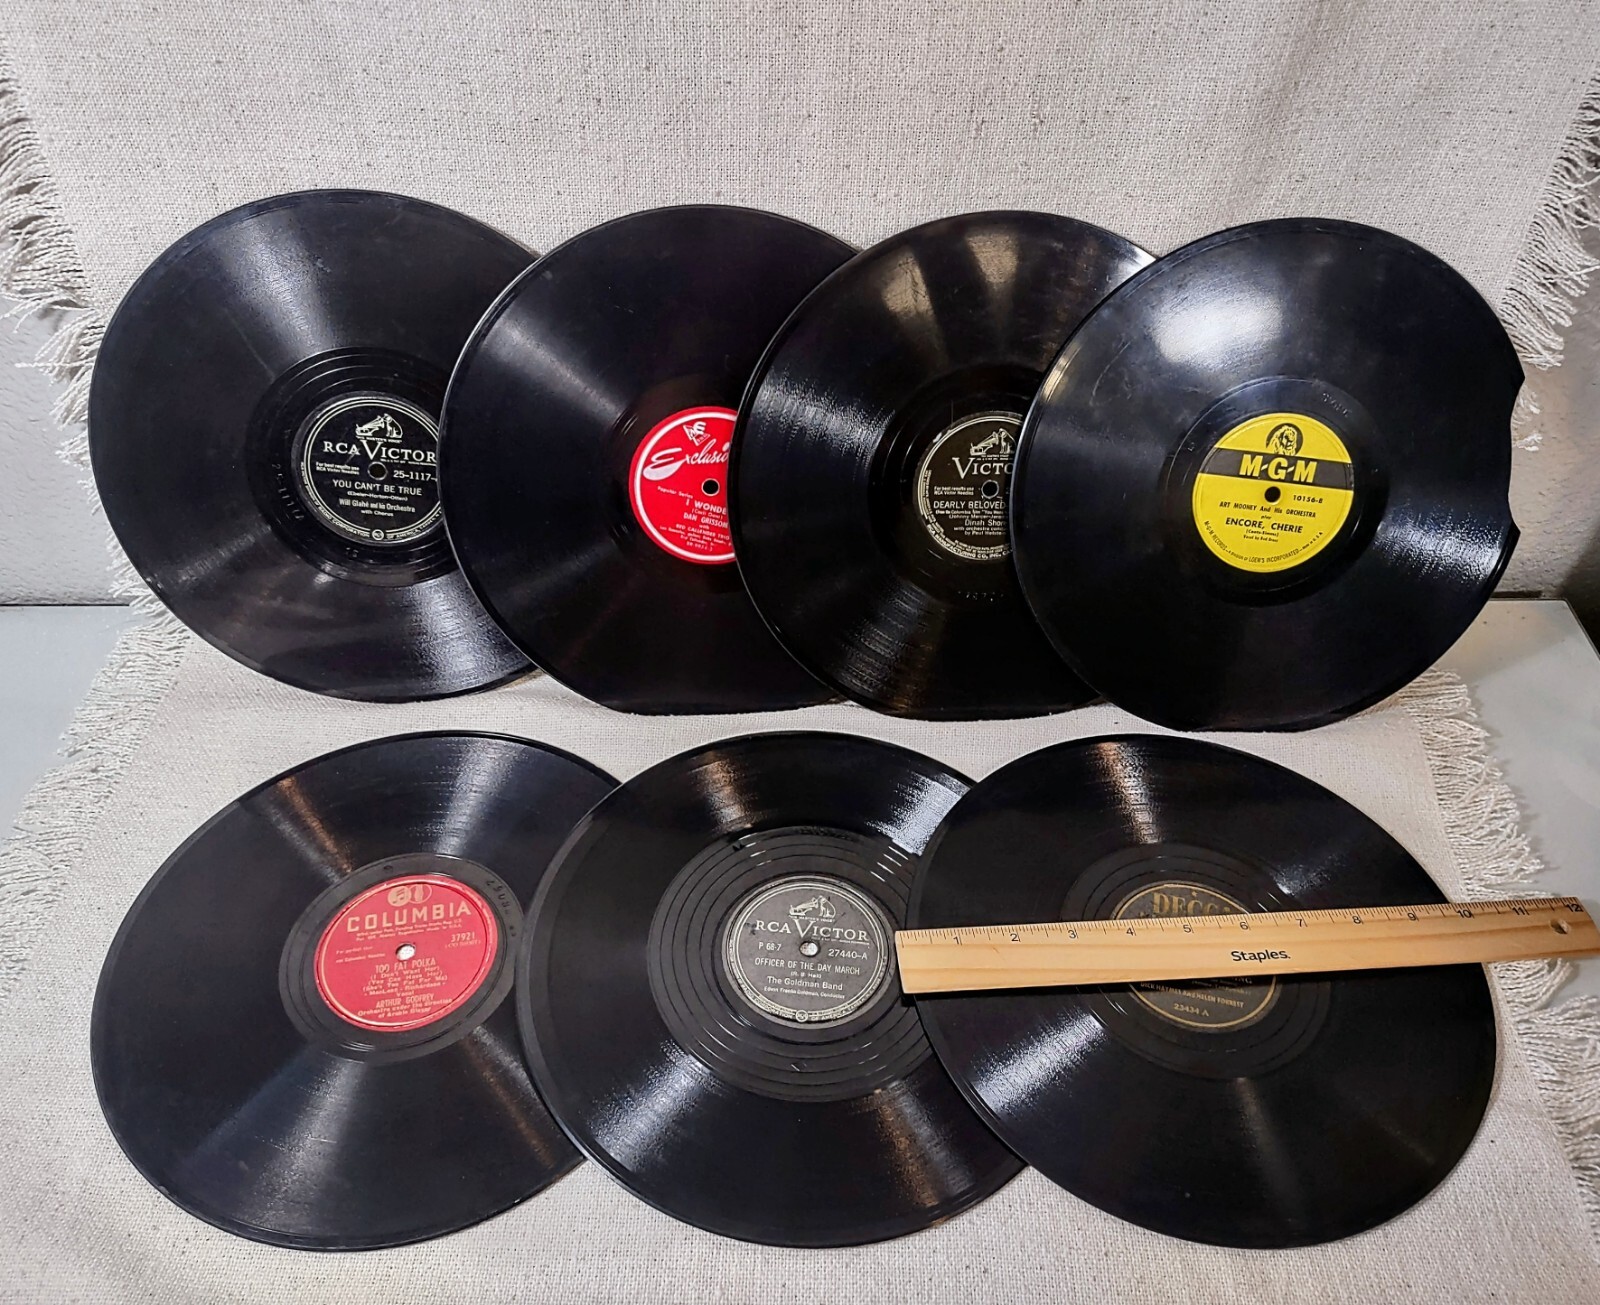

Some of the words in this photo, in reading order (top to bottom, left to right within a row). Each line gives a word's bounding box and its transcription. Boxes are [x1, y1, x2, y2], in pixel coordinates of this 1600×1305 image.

[323, 441, 360, 456] RCA
[360, 439, 437, 463] VICTOR
[951, 456, 1014, 480] VICTO
[393, 470, 437, 482] 25-1117-
[332, 478, 352, 489] YOU
[354, 481, 381, 492] CAN'T
[383, 484, 396, 493] BE
[397, 485, 422, 496] TRUE
[386, 503, 415, 513] Orchestra
[694, 500, 727, 515] WONDE
[933, 500, 966, 509] DEARLY
[968, 500, 1006, 510] BELOVED
[1219, 501, 1231, 509] ART
[1233, 502, 1257, 511] MOONEY
[1259, 505, 1271, 513] And
[1285, 508, 1316, 518] ORCHESTRA
[683, 511, 698, 522] DAN
[964, 519, 985, 527] Dinah
[1225, 517, 1265, 530] ENCORE,
[1270, 522, 1303, 534] CHERIE
[1152, 892, 1230, 917] DECC
[346, 902, 472, 933] COLUMBIA
[755, 919, 792, 934] RCA
[793, 919, 870, 941] VICTOR
[953, 936, 960, 945] 1
[1010, 933, 1018, 942] 2
[1067, 929, 1076, 939] 3
[1125, 927, 1134, 936] 4
[1183, 924, 1192, 933] 5
[1239, 921, 1249, 931] 6
[1295, 918, 1303, 927] 7
[1352, 915, 1361, 924] 8
[1407, 912, 1417, 921] 9
[1456, 909, 1472, 918] 10
[450, 931, 475, 943] 37921
[758, 941, 764, 950] P
[828, 948, 868, 960] 27440-A
[394, 960, 408, 971] FAT
[411, 957, 436, 969] POLKA
[754, 957, 785, 968] OFFICER
[787, 960, 798, 969] OF
[799, 961, 815, 971] THE
[817, 963, 832, 972] DAY
[834, 965, 860, 975] MARCH
[767, 975, 782, 985] The
[784, 977, 819, 988] Goldman
[822, 981, 843, 991] Band
[375, 997, 402, 1008] ARTHUR
[405, 993, 435, 1004] GODFREY
